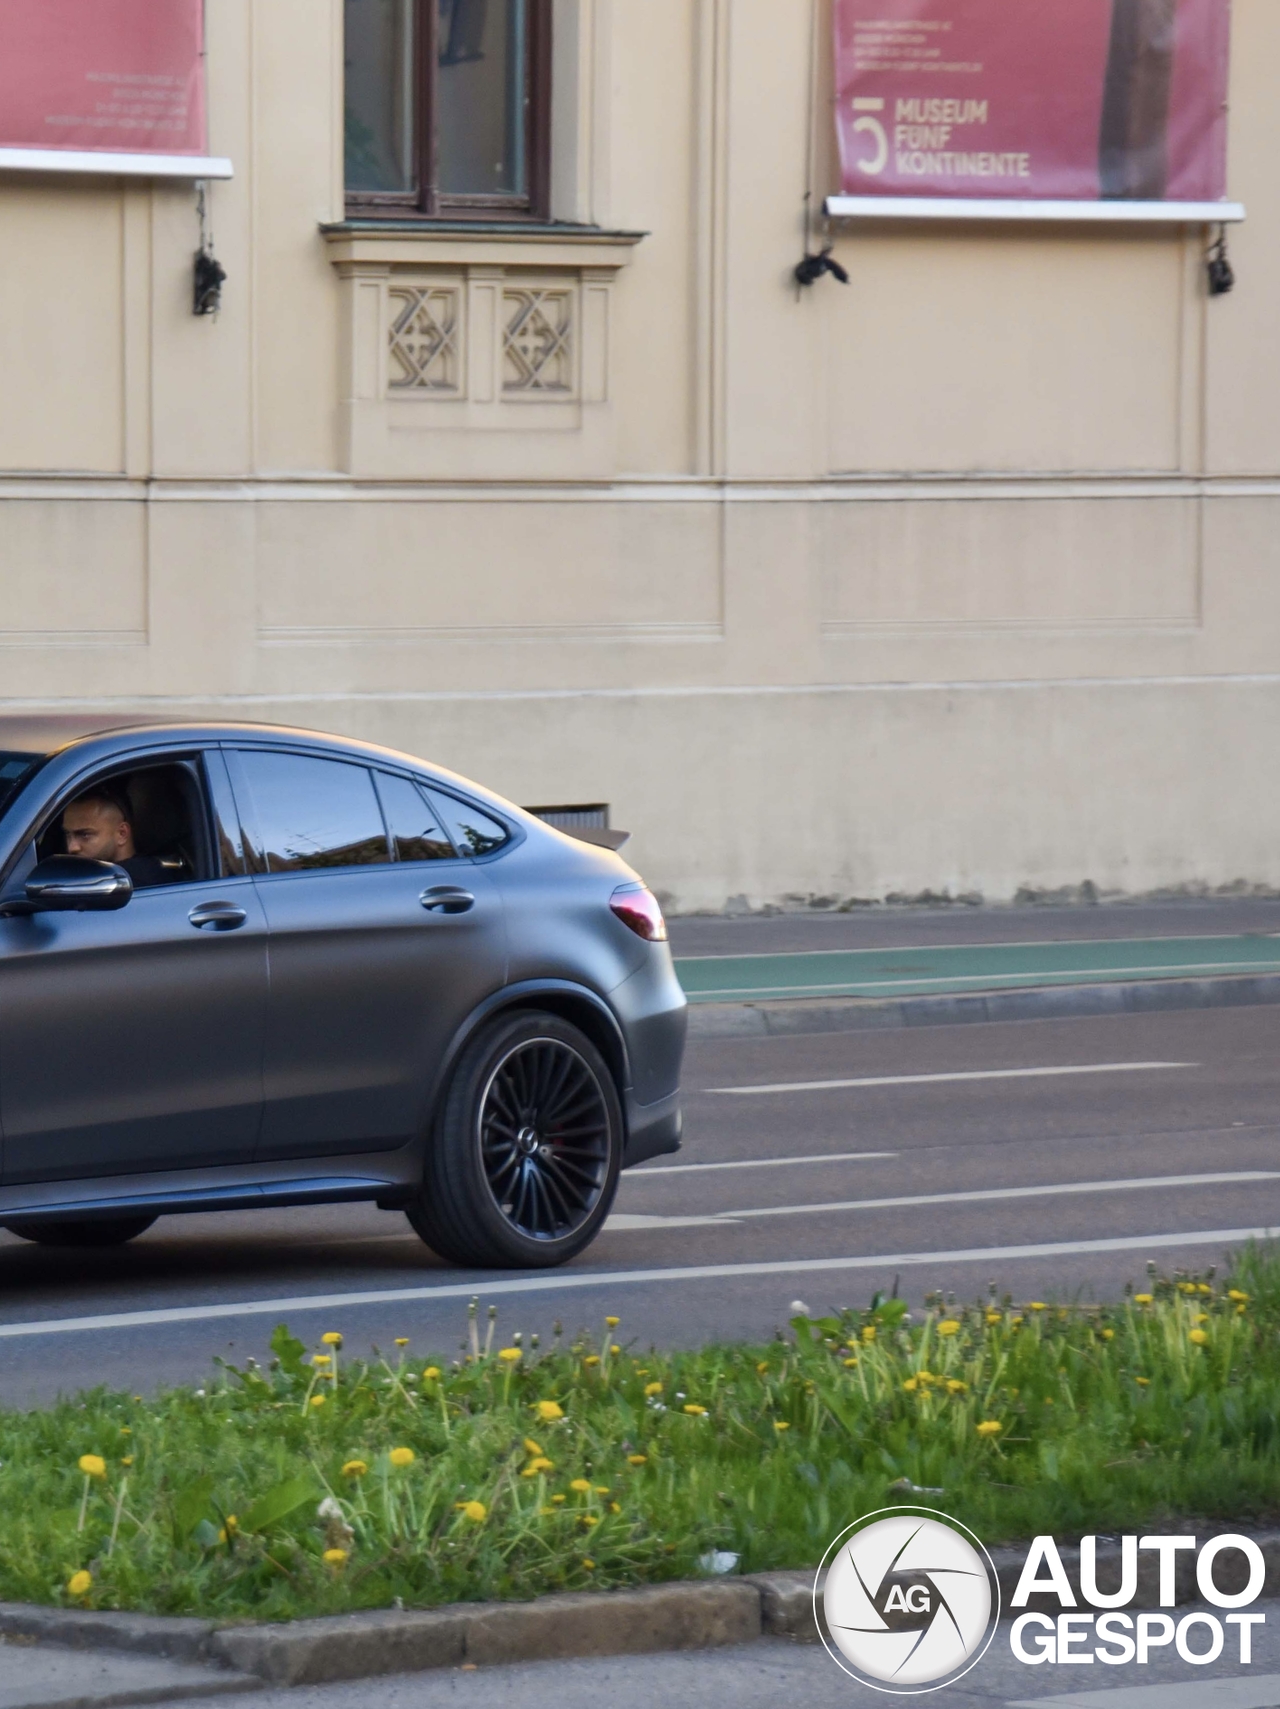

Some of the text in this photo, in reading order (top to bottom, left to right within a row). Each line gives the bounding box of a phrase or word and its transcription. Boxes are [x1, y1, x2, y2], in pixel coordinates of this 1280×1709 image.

[895, 98, 988, 124] MUSEUM
[852, 97, 888, 175] 5
[895, 125, 953, 149] FÜNF
[896, 151, 1030, 176] KONTINENTE
